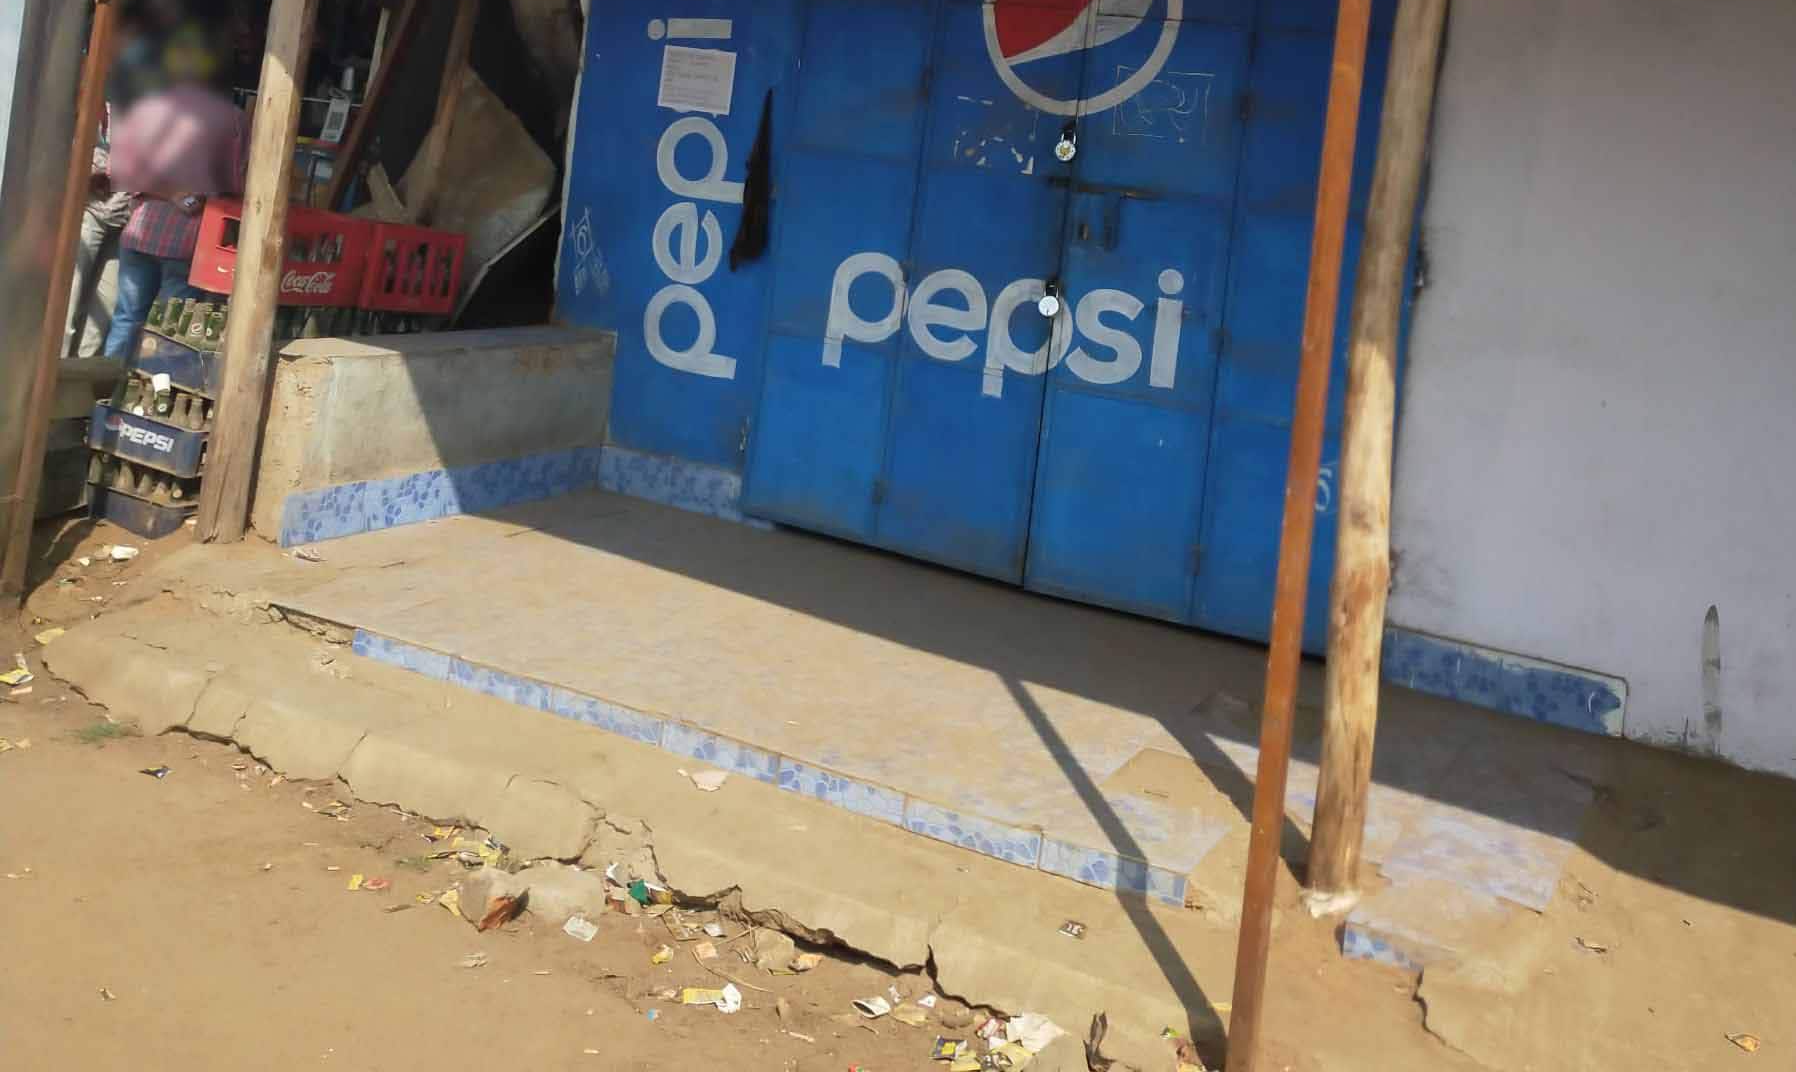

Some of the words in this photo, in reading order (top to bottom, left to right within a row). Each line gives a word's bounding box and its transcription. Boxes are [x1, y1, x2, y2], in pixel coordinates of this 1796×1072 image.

[643, 18, 744, 380] pepi
[822, 252, 1184, 399] pepsi
[118, 421, 175, 453] PEPSI
